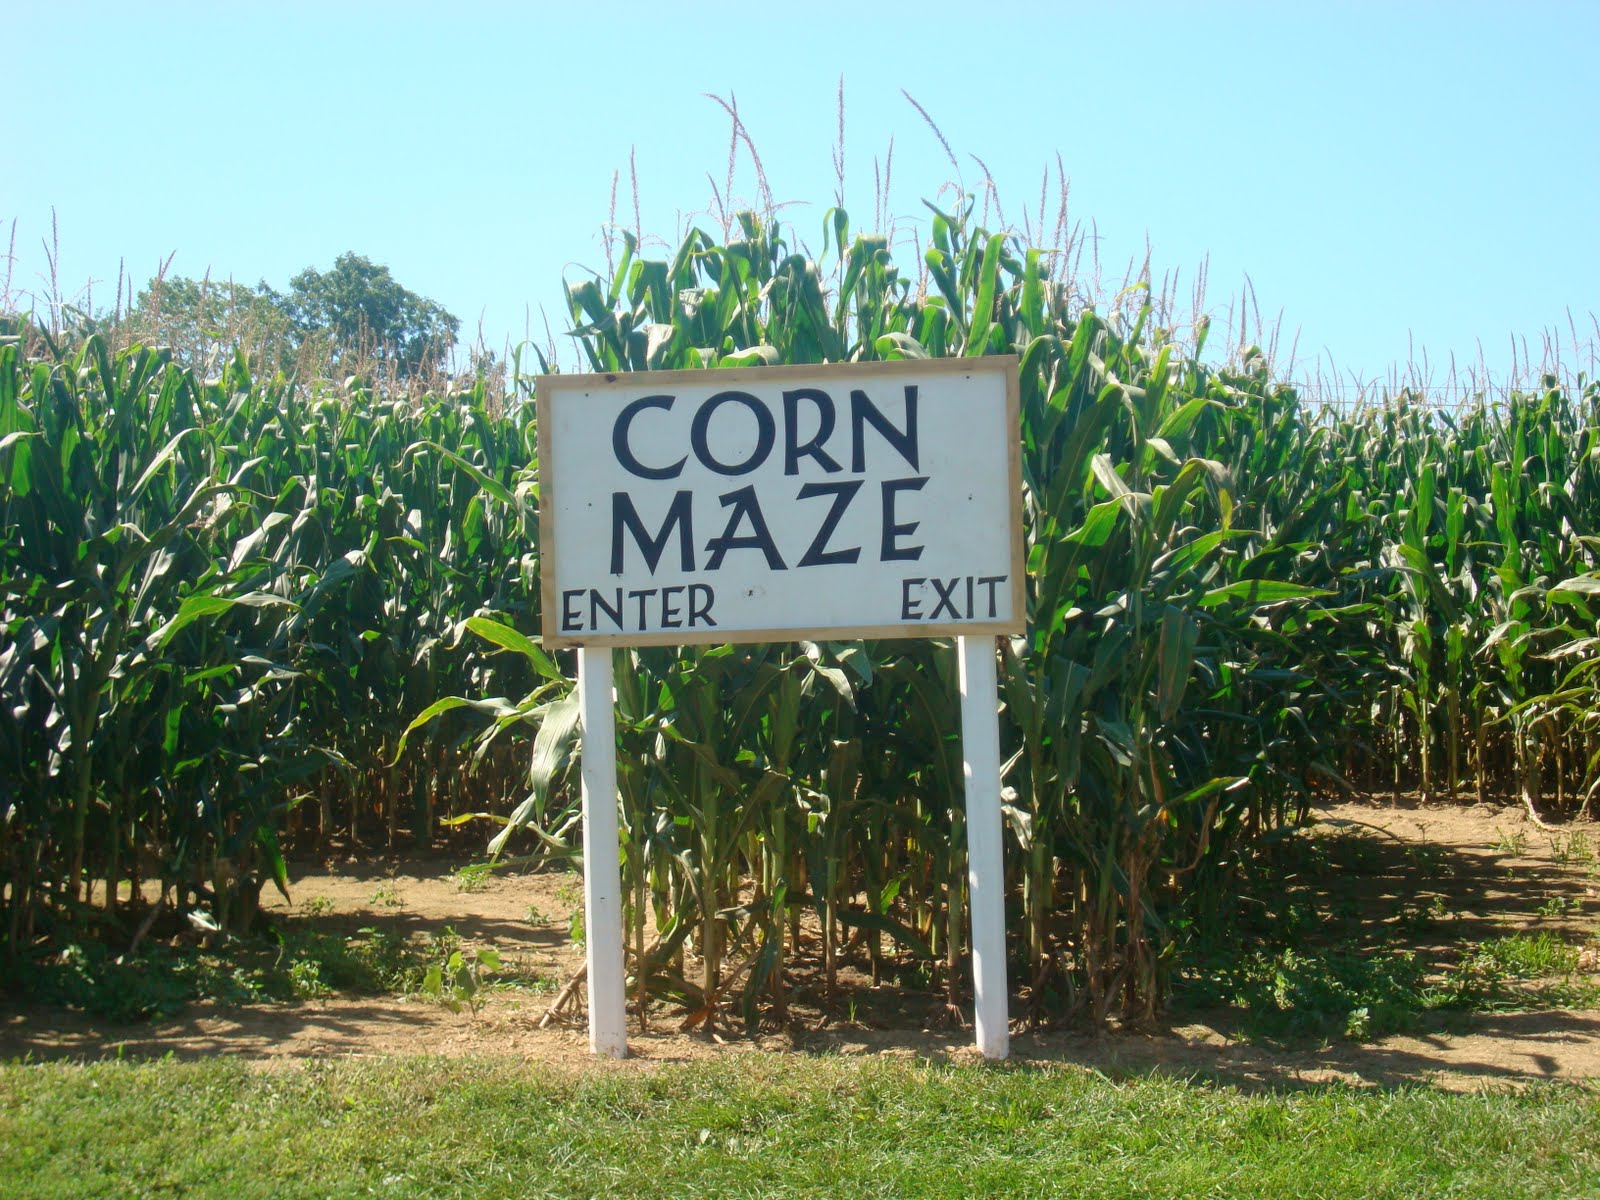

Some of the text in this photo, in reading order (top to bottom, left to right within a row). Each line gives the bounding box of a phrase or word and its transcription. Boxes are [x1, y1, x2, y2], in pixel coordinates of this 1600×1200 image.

[613, 385, 919, 480] CORN
[610, 477, 930, 577] MAZE
[562, 584, 717, 631] ENTER
[901, 575, 1008, 620] EXIT
